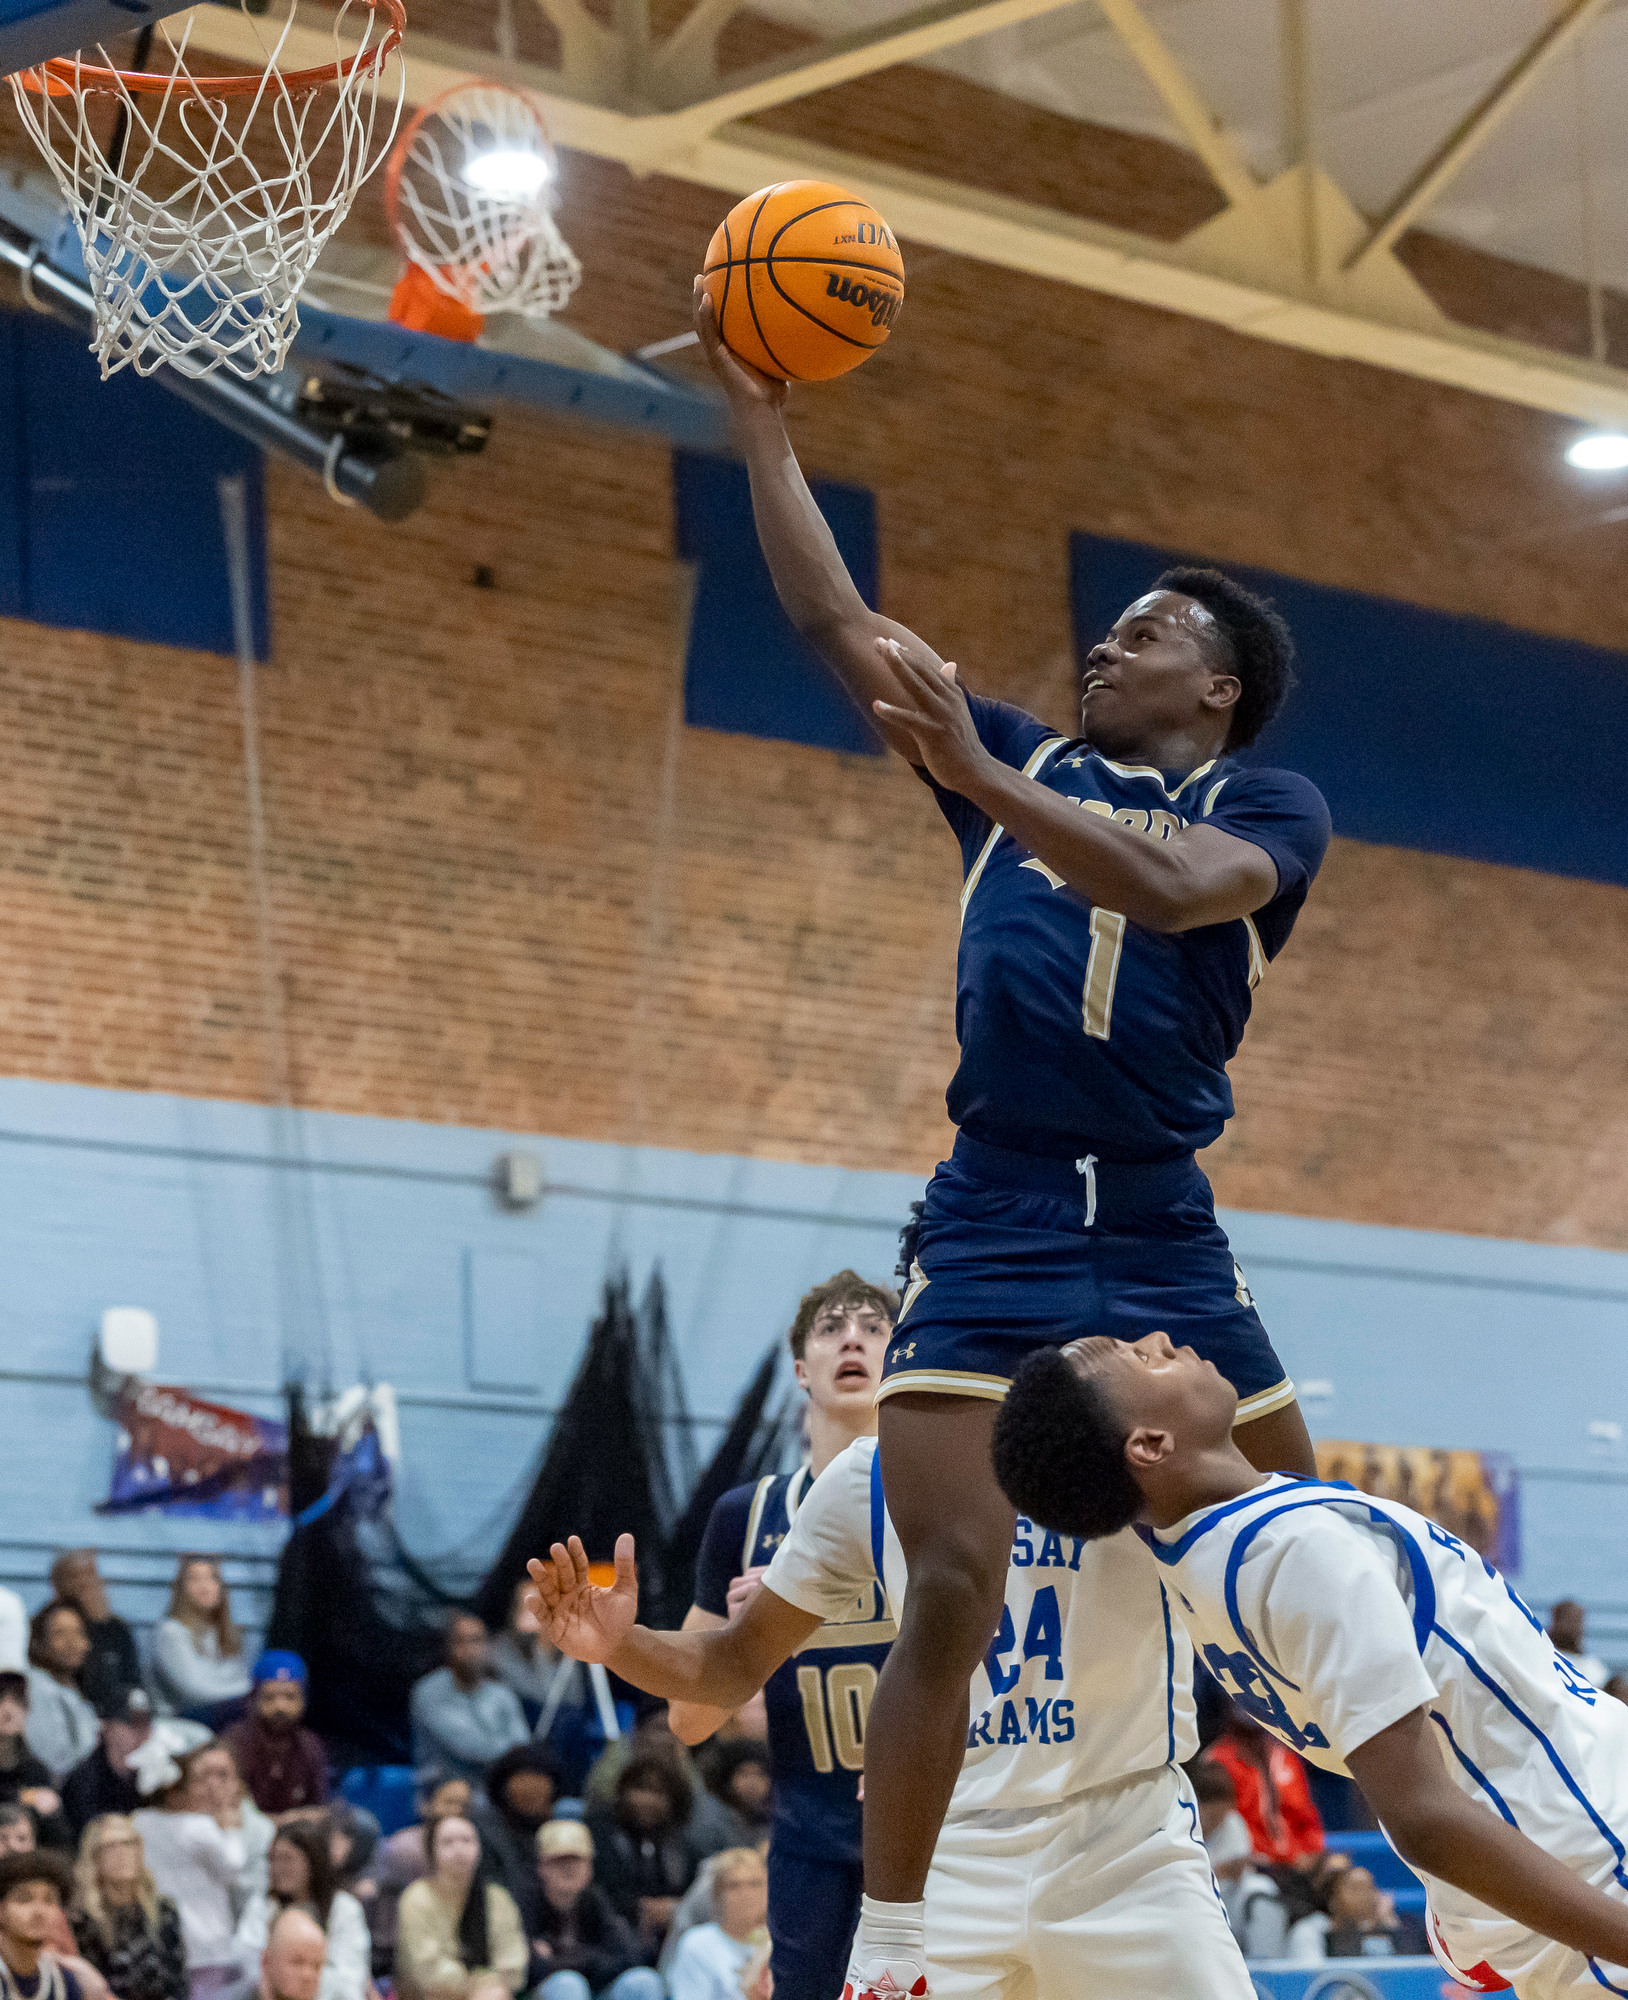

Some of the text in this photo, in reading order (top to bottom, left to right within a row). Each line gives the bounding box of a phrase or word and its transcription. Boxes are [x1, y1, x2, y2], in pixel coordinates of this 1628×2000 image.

[833, 235, 856, 245] NXT
[826, 272, 903, 329] ilson
[1082, 906, 1127, 1041] 1
[1012, 1518, 1082, 1573] SAY
[982, 1584, 1064, 1698] 24
[796, 1663, 879, 1774] 10
[966, 1697, 1075, 1749] RAMS
